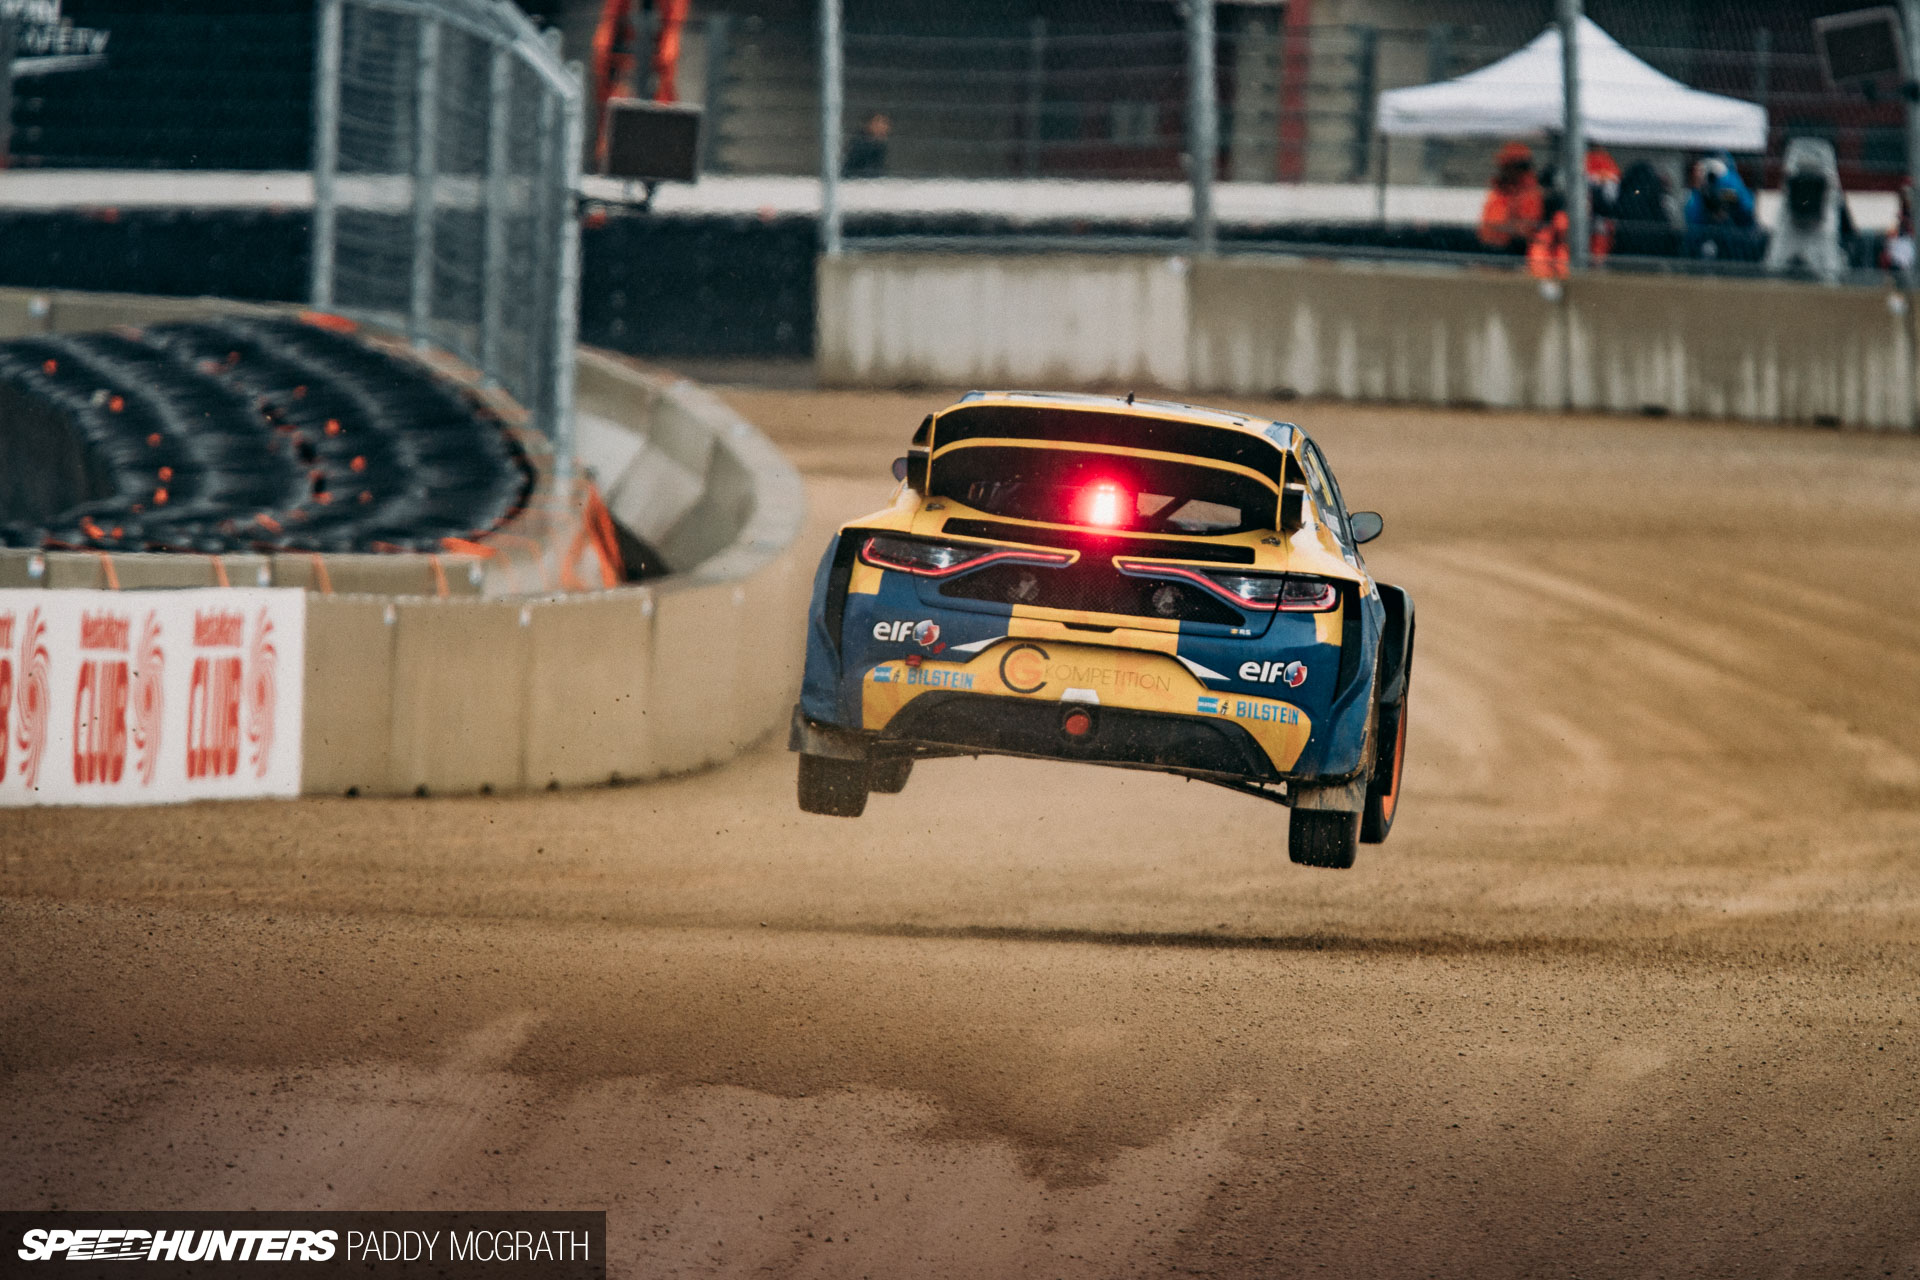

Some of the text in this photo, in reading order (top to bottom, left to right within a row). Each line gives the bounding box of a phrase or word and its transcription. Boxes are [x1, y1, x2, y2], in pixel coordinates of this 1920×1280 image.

[873, 620, 915, 642] elf
[907, 668, 975, 689] BILSTEIN
[1239, 661, 1285, 683] elf
[1236, 701, 1299, 725] BILSTEIN
